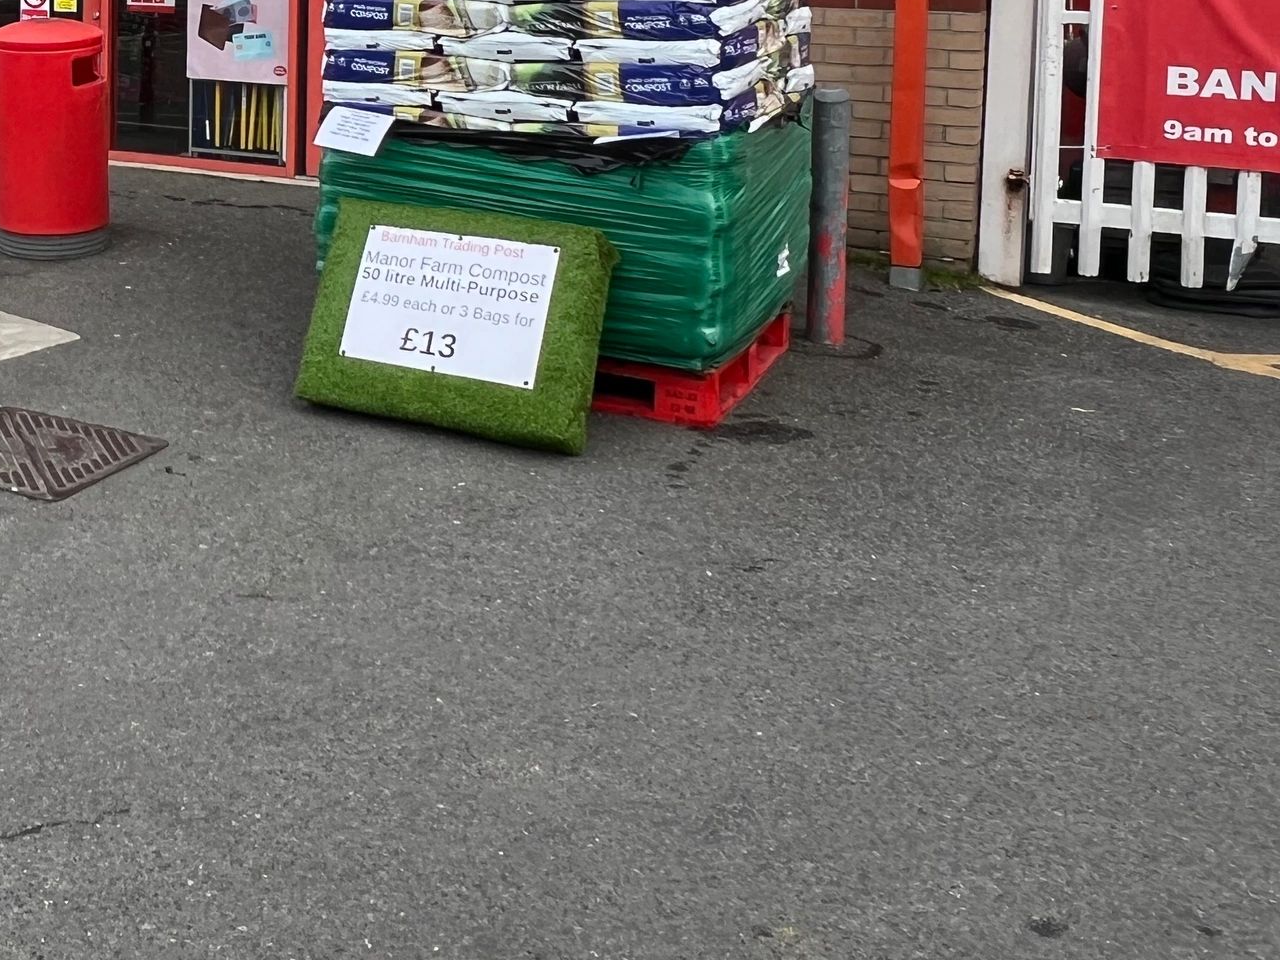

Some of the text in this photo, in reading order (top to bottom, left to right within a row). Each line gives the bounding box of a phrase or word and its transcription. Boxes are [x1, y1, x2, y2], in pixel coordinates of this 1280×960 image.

[350, 9, 389, 20] COMPOST
[351, 62, 390, 75] COMPOST
[1166, 65, 1277, 103] BAN
[1163, 119, 1279, 148] 9am to
[381, 230, 524, 258] Barnham Trading Post
[365, 250, 547, 287] Manor Farm Compost
[362, 266, 539, 304] 50 litre Multi-Purpose
[360, 290, 536, 328] £4.99 each or 3 Bags for
[399, 327, 457, 359] £13
